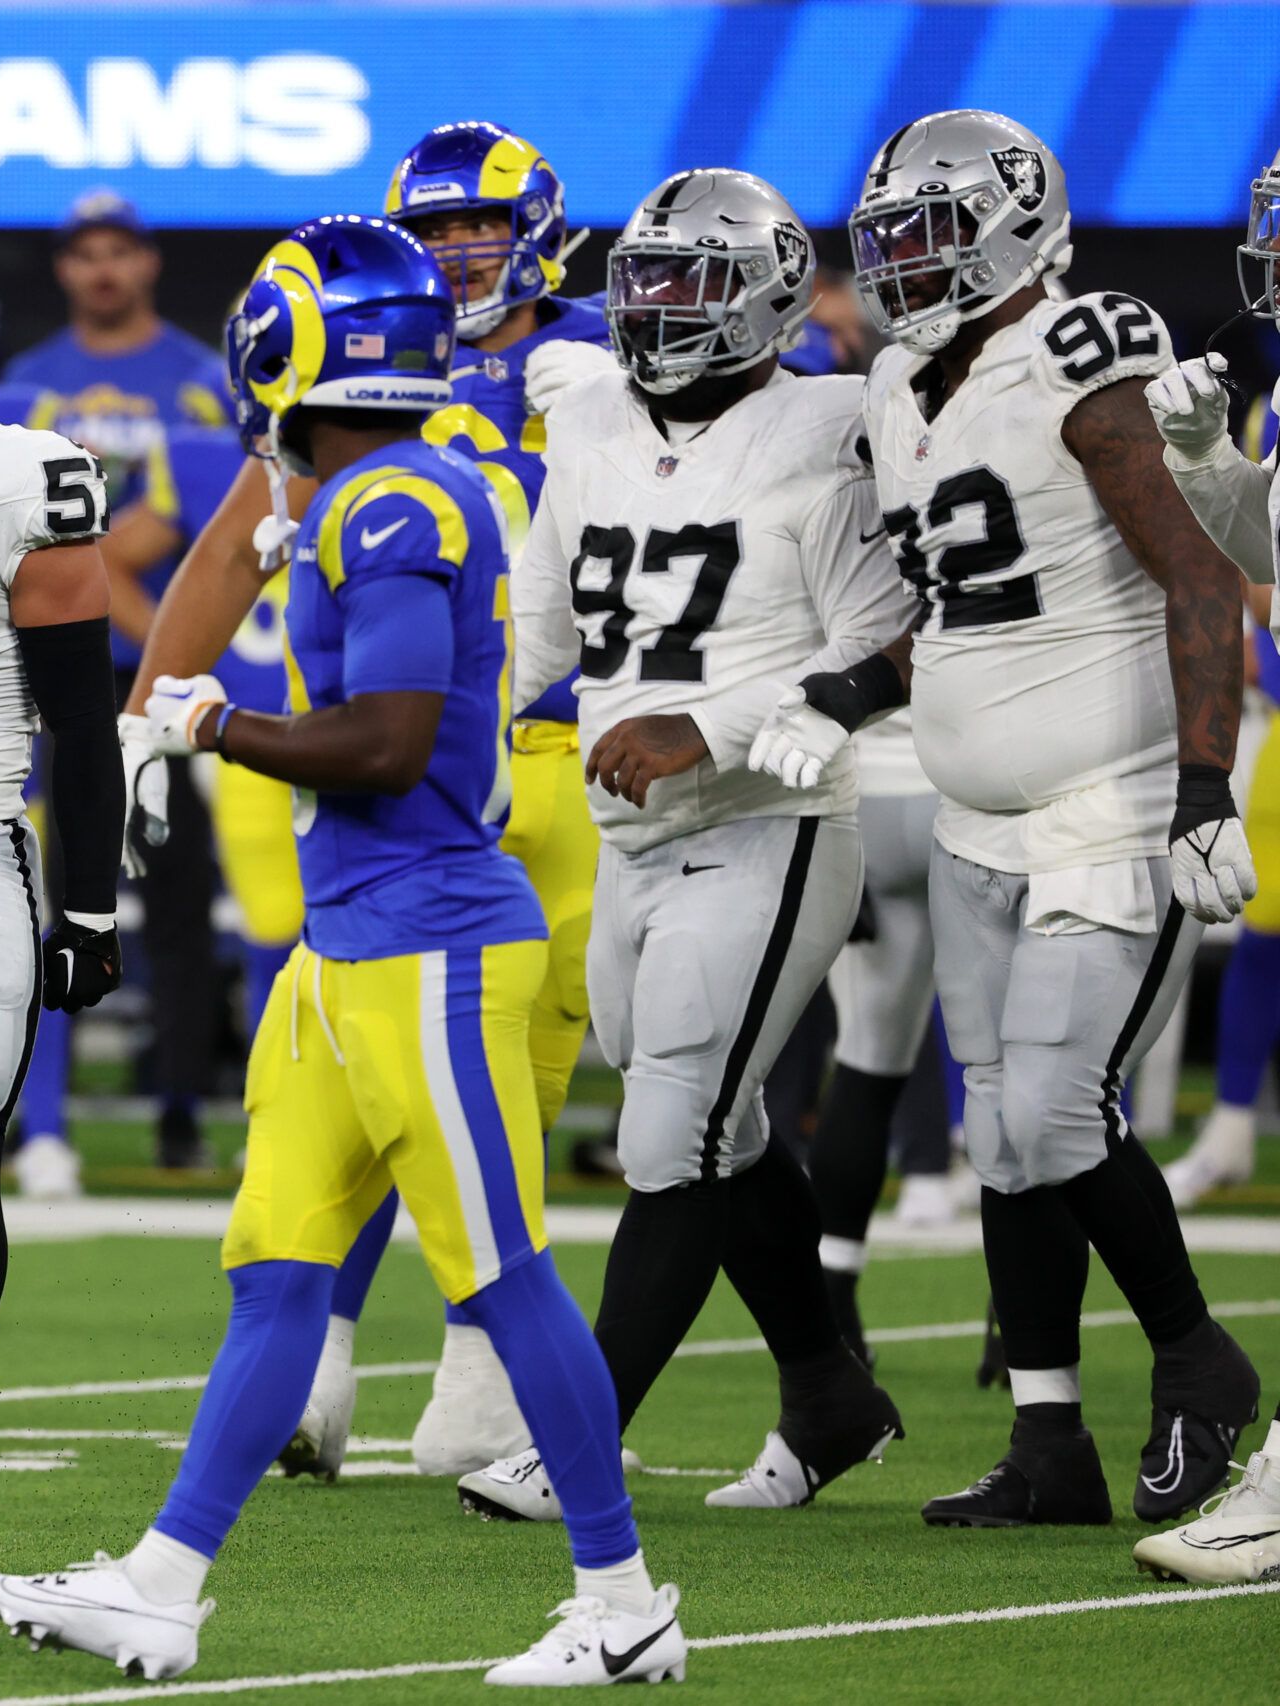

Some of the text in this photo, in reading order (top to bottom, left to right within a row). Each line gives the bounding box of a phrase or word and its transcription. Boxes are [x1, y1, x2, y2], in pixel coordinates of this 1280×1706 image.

[996, 152, 1038, 161] RAIDERS
[1042, 293, 1160, 383] 92
[345, 389, 383, 400] LOS
[570, 518, 746, 686] 97
